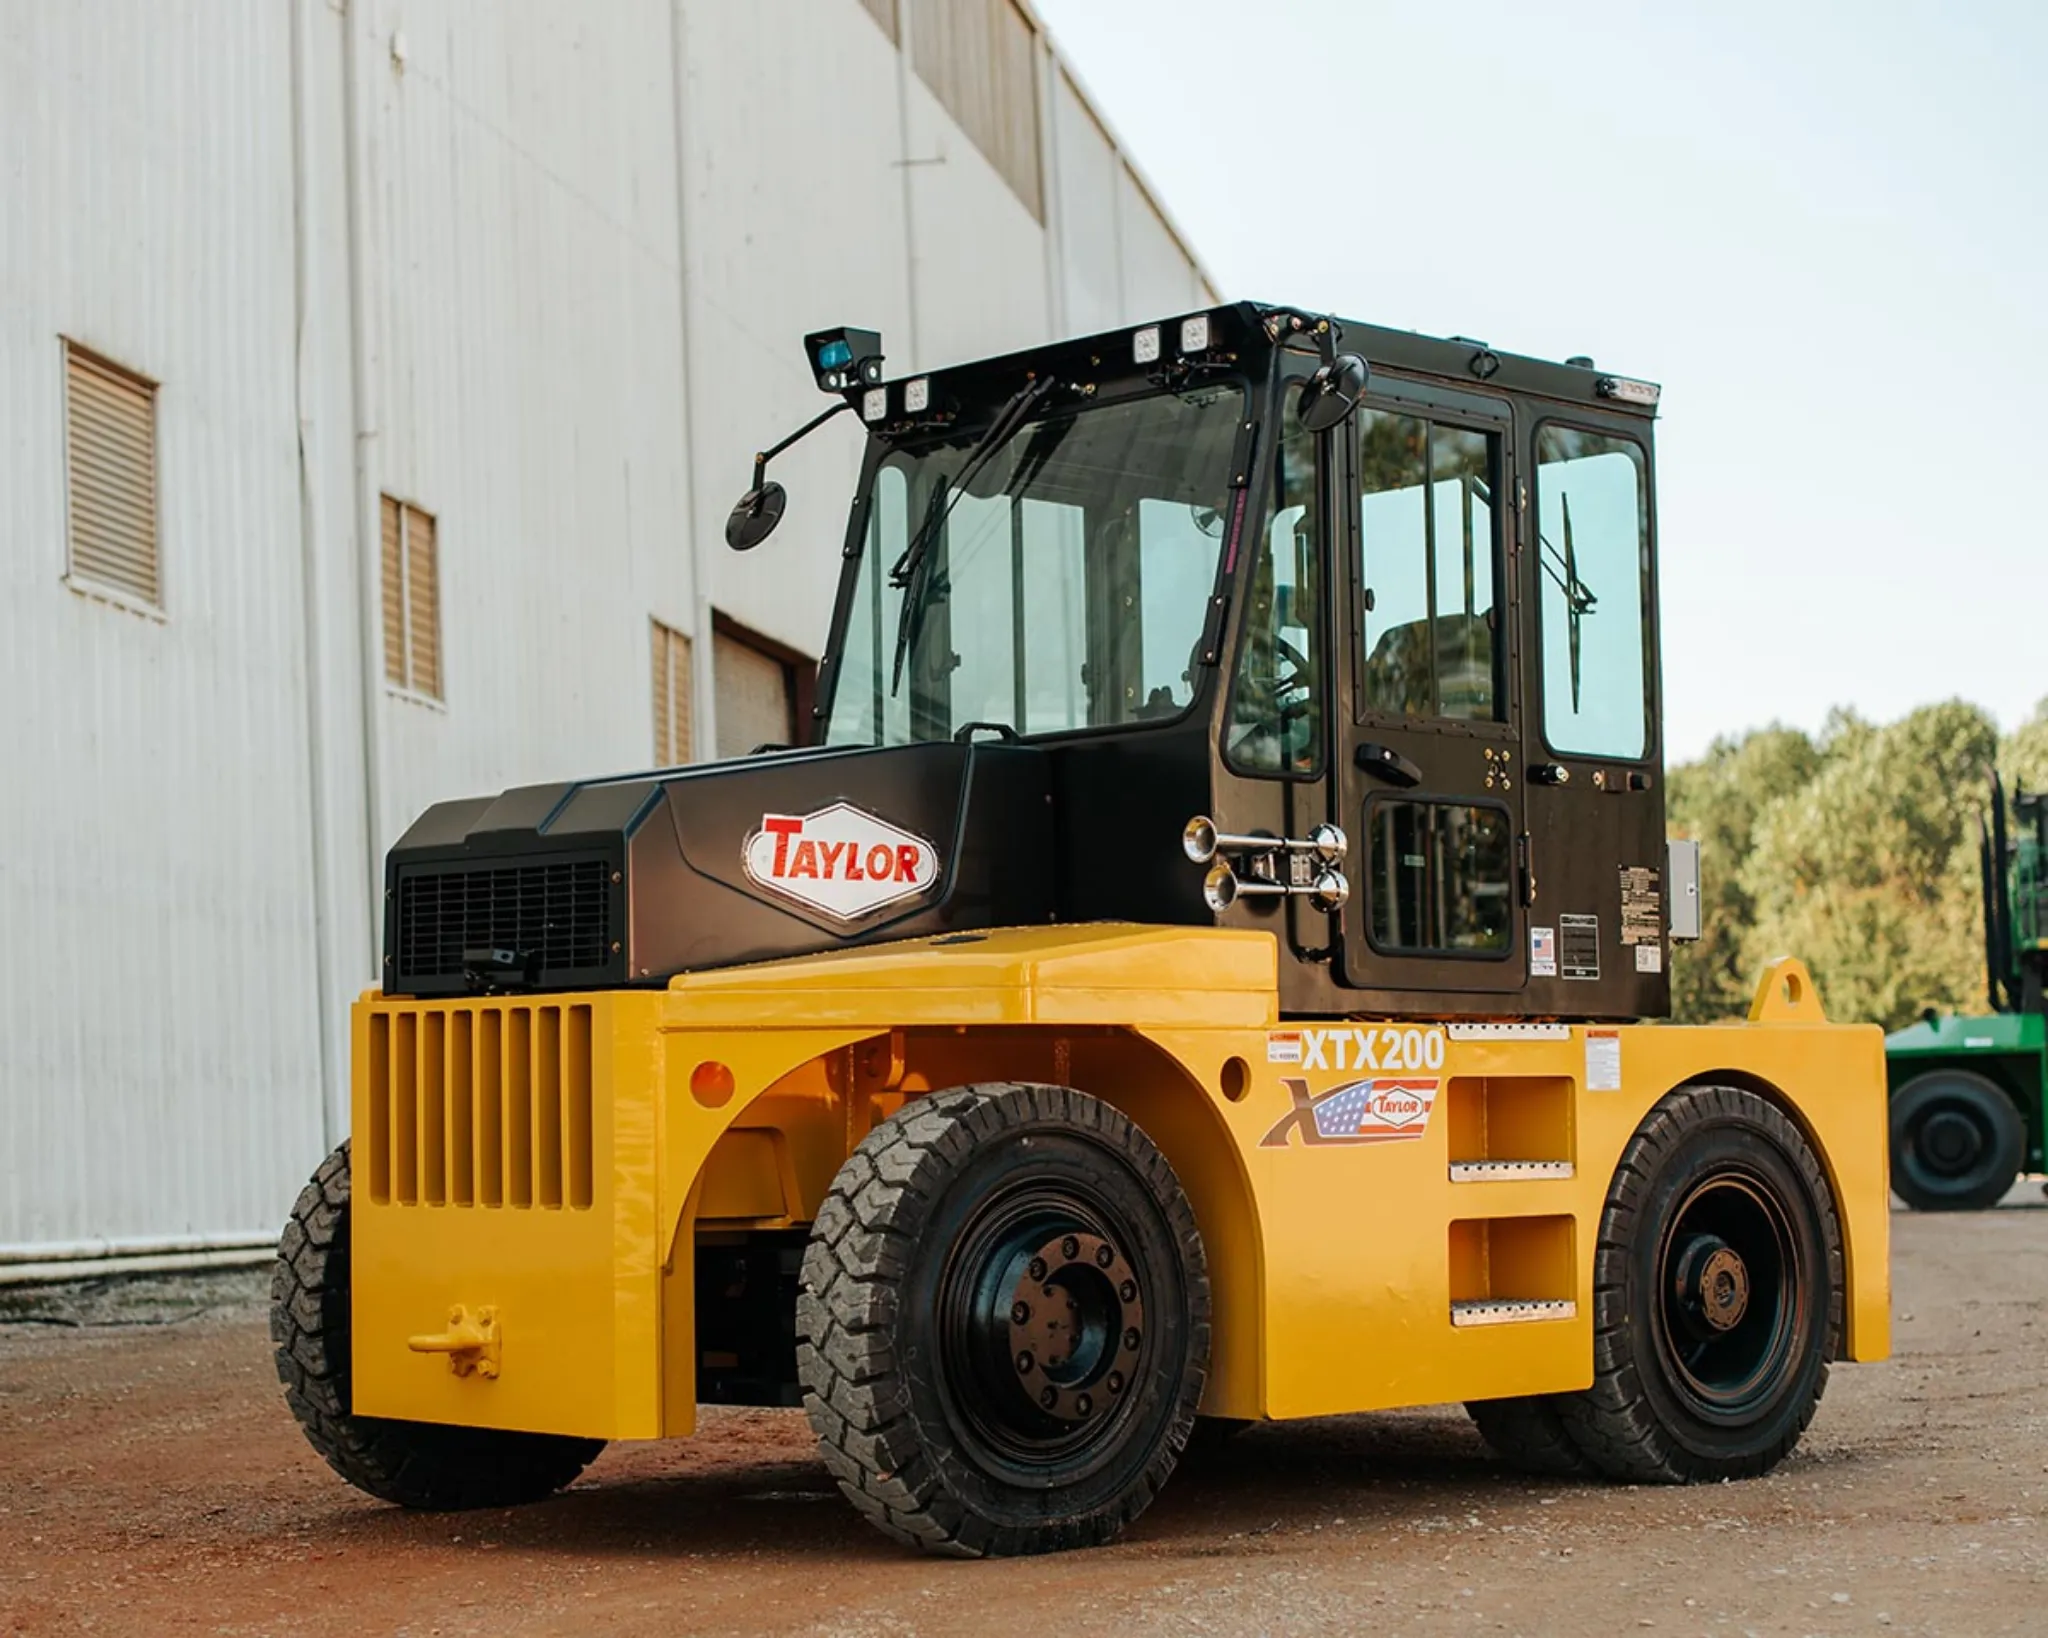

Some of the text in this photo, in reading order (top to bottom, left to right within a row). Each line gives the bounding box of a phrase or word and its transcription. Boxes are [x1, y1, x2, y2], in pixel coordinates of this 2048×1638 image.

[765, 818, 919, 882] TAYLOR
[1301, 1029, 1444, 1070] XTX200
[1378, 1095, 1418, 1113] TAYLOR
